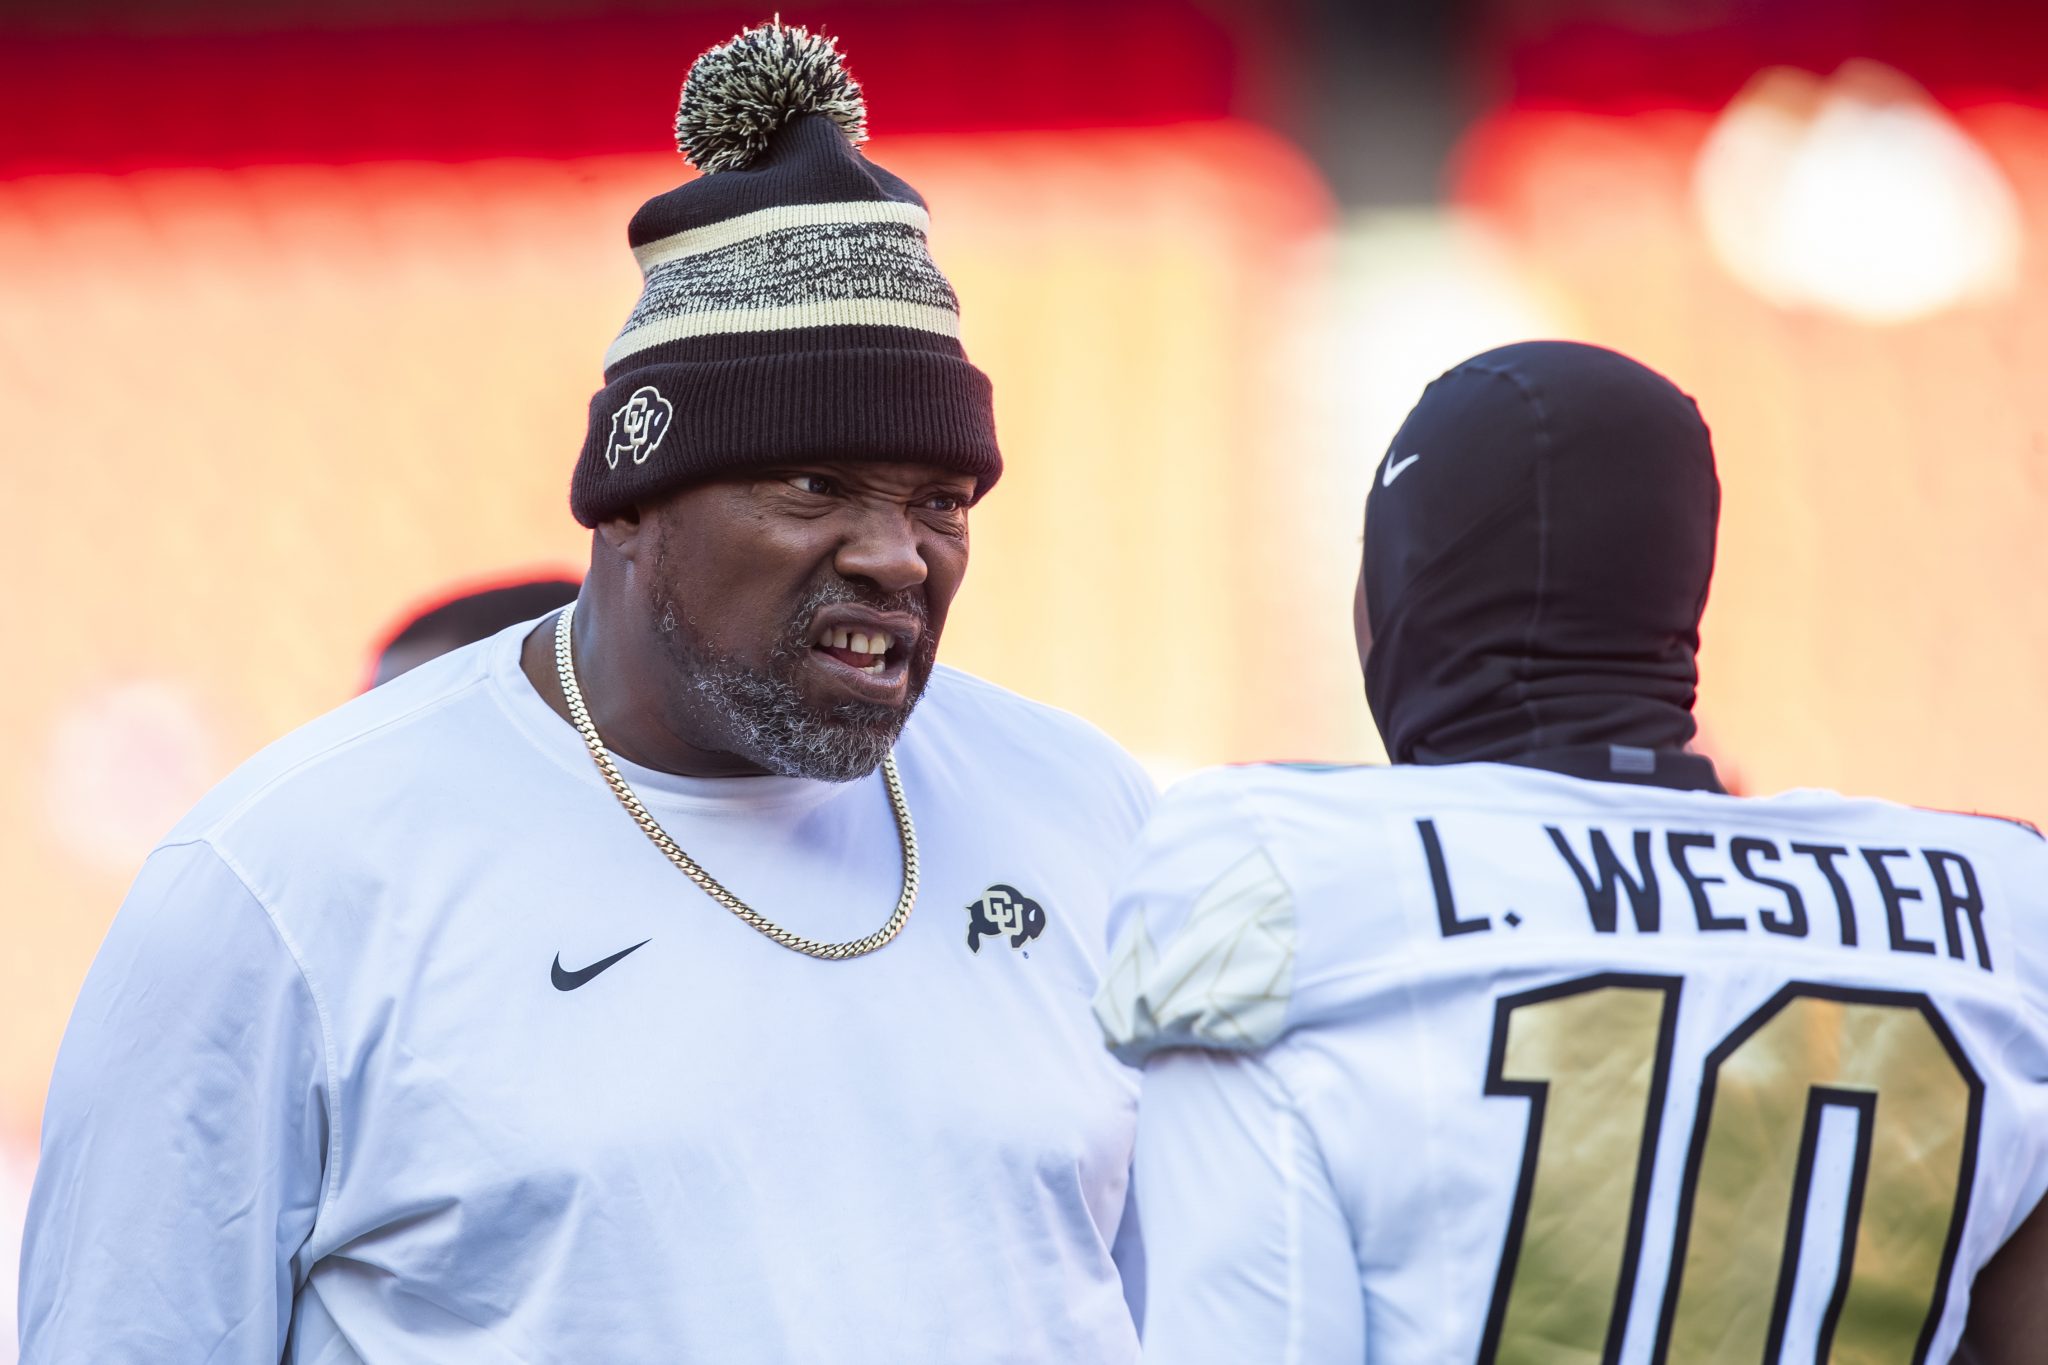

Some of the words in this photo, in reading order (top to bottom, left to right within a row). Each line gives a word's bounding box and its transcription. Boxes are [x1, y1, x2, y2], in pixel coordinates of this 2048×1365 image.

[982, 890, 1023, 936] CU
[1415, 818, 1522, 938] L.
[1544, 824, 1993, 972] WESTER
[1477, 972, 1986, 1365] 10
